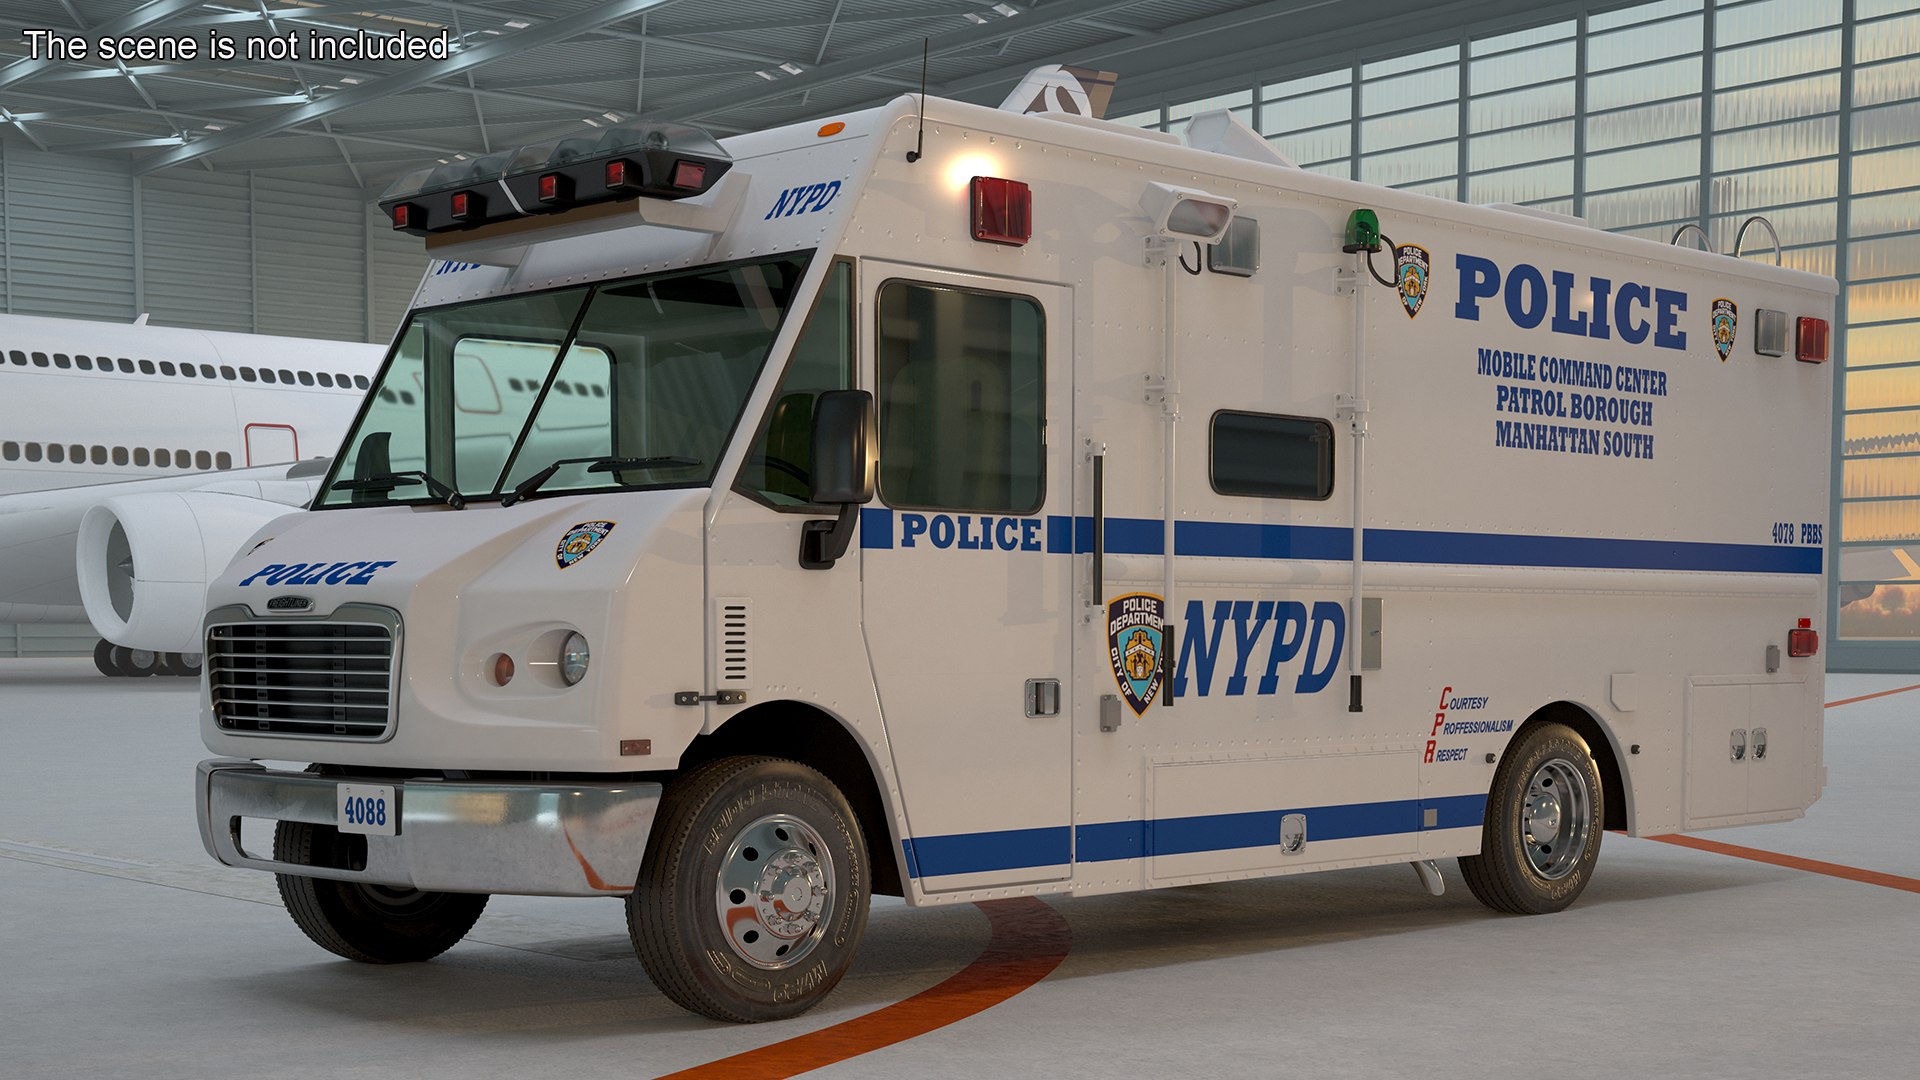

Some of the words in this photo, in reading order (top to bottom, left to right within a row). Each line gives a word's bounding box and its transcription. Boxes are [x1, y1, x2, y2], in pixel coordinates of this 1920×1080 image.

[764, 180, 842, 221] NYPD
[1455, 253, 1687, 350] POLICE
[1478, 348, 1536, 381] MOBILE
[1539, 355, 1613, 390] COMMAND
[1616, 365, 1667, 397] CENTER
[1496, 385, 1567, 417] PATROL
[1571, 393, 1653, 426] BOROUGH
[1496, 420, 1600, 455] MANHATTAN
[1604, 430, 1654, 459] SOUTH
[901, 513, 1042, 551] POLICE
[1772, 522, 1795, 544] 4078
[1801, 523, 1823, 545] PBBS
[239, 560, 398, 587] POLICE
[1110, 612, 1164, 636] DEPARTMEN
[1123, 598, 1158, 613] POLICE
[1173, 600, 1346, 697] NYPD
[1110, 646, 1124, 678] CITY
[1121, 681, 1132, 696] OF
[1143, 678, 1159, 704] NEW
[345, 796, 386, 826] 4088
